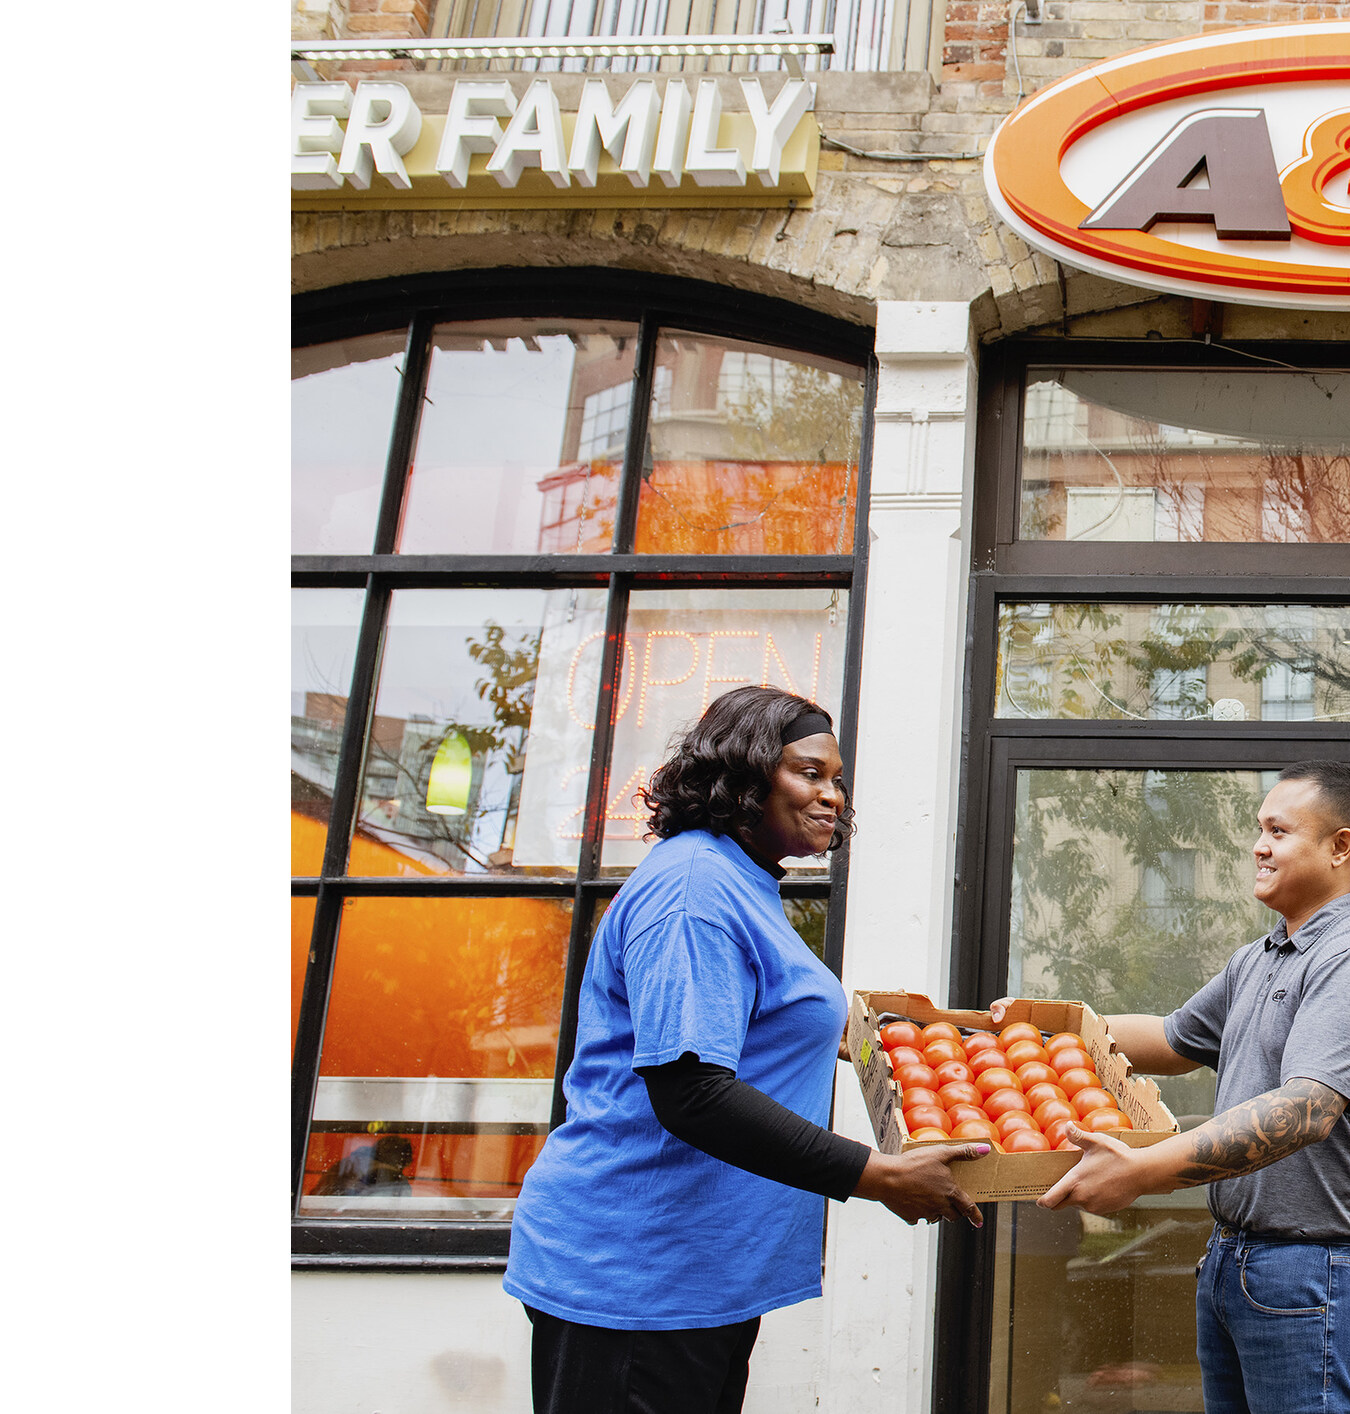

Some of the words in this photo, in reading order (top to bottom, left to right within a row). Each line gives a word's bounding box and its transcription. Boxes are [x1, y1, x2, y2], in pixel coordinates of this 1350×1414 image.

[290, 79, 422, 190] ER
[436, 78, 813, 189] FAMILY
[567, 629, 823, 730] OPEN
